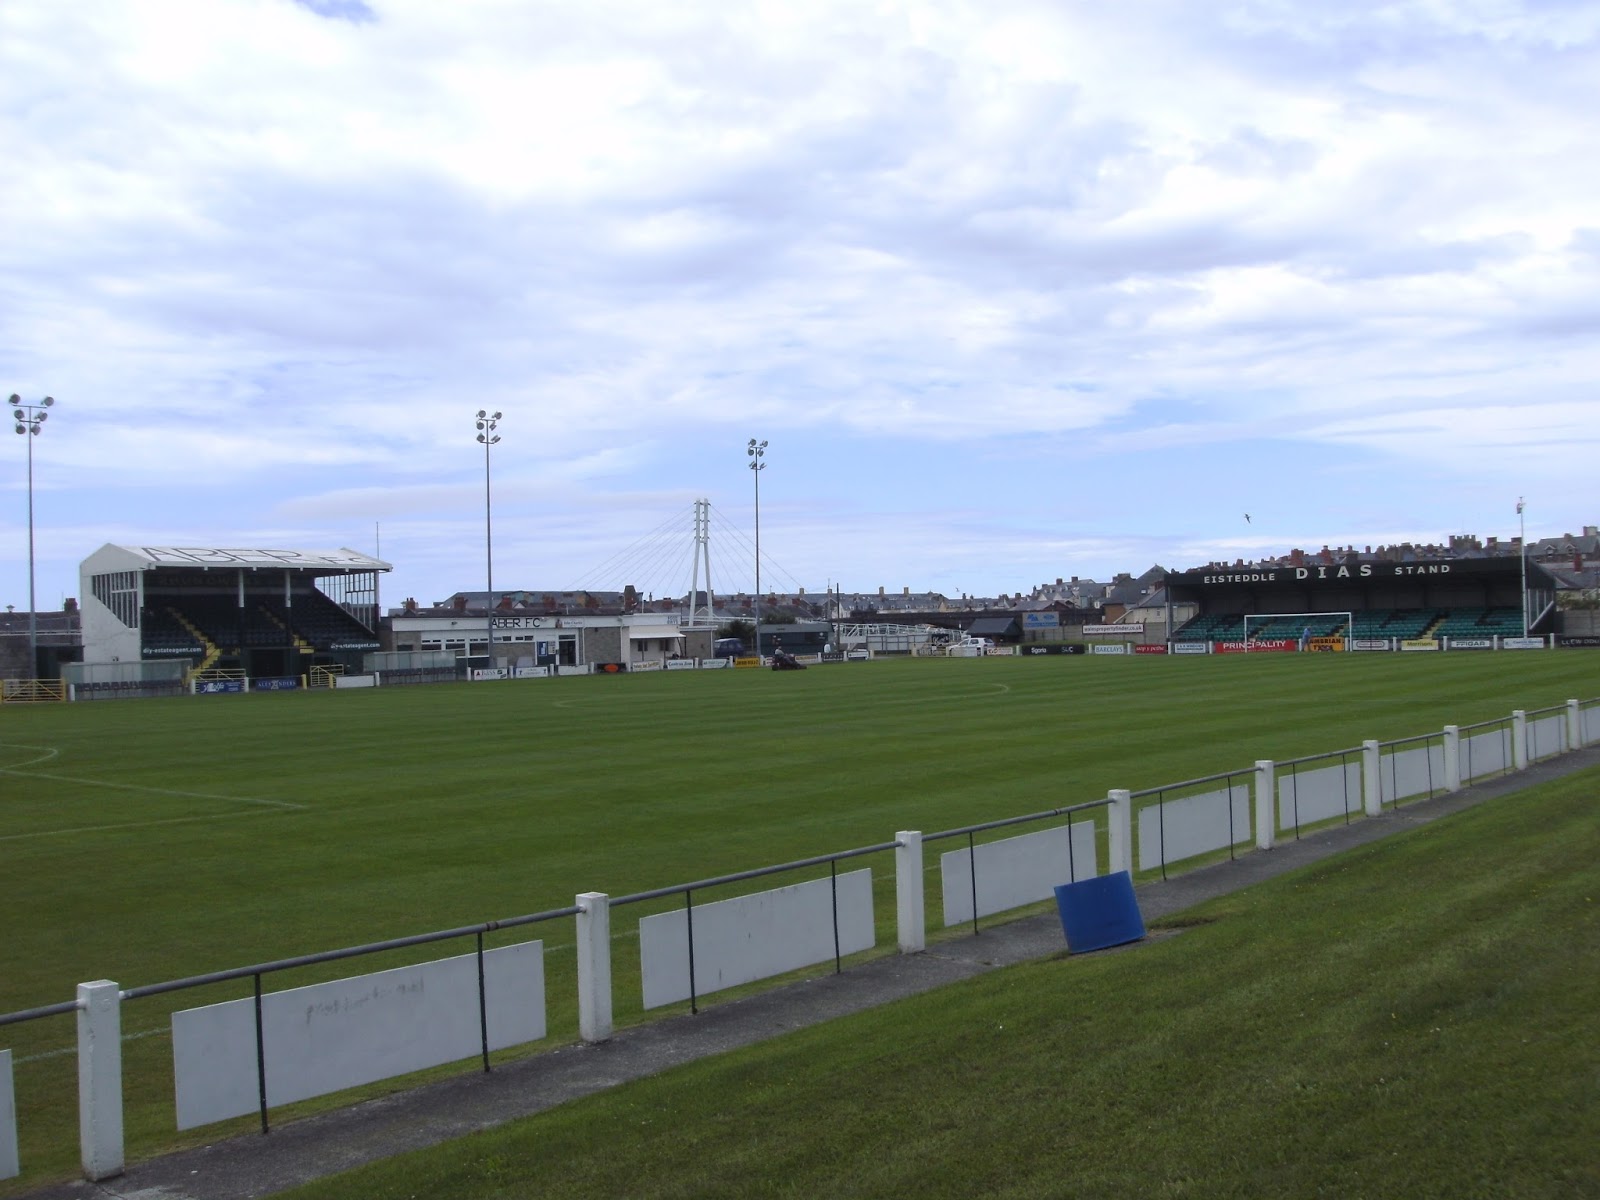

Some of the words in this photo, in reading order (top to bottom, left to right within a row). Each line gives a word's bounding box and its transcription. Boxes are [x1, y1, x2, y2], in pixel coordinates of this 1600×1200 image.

[1204, 573, 1276, 584] EISTEDDLE
[1296, 564, 1372, 580] DIAS
[1395, 565, 1450, 575] STAND
[491, 617, 521, 629] ABER
[525, 617, 541, 628] FC
[1223, 640, 1287, 649] PRINCIPALITY
